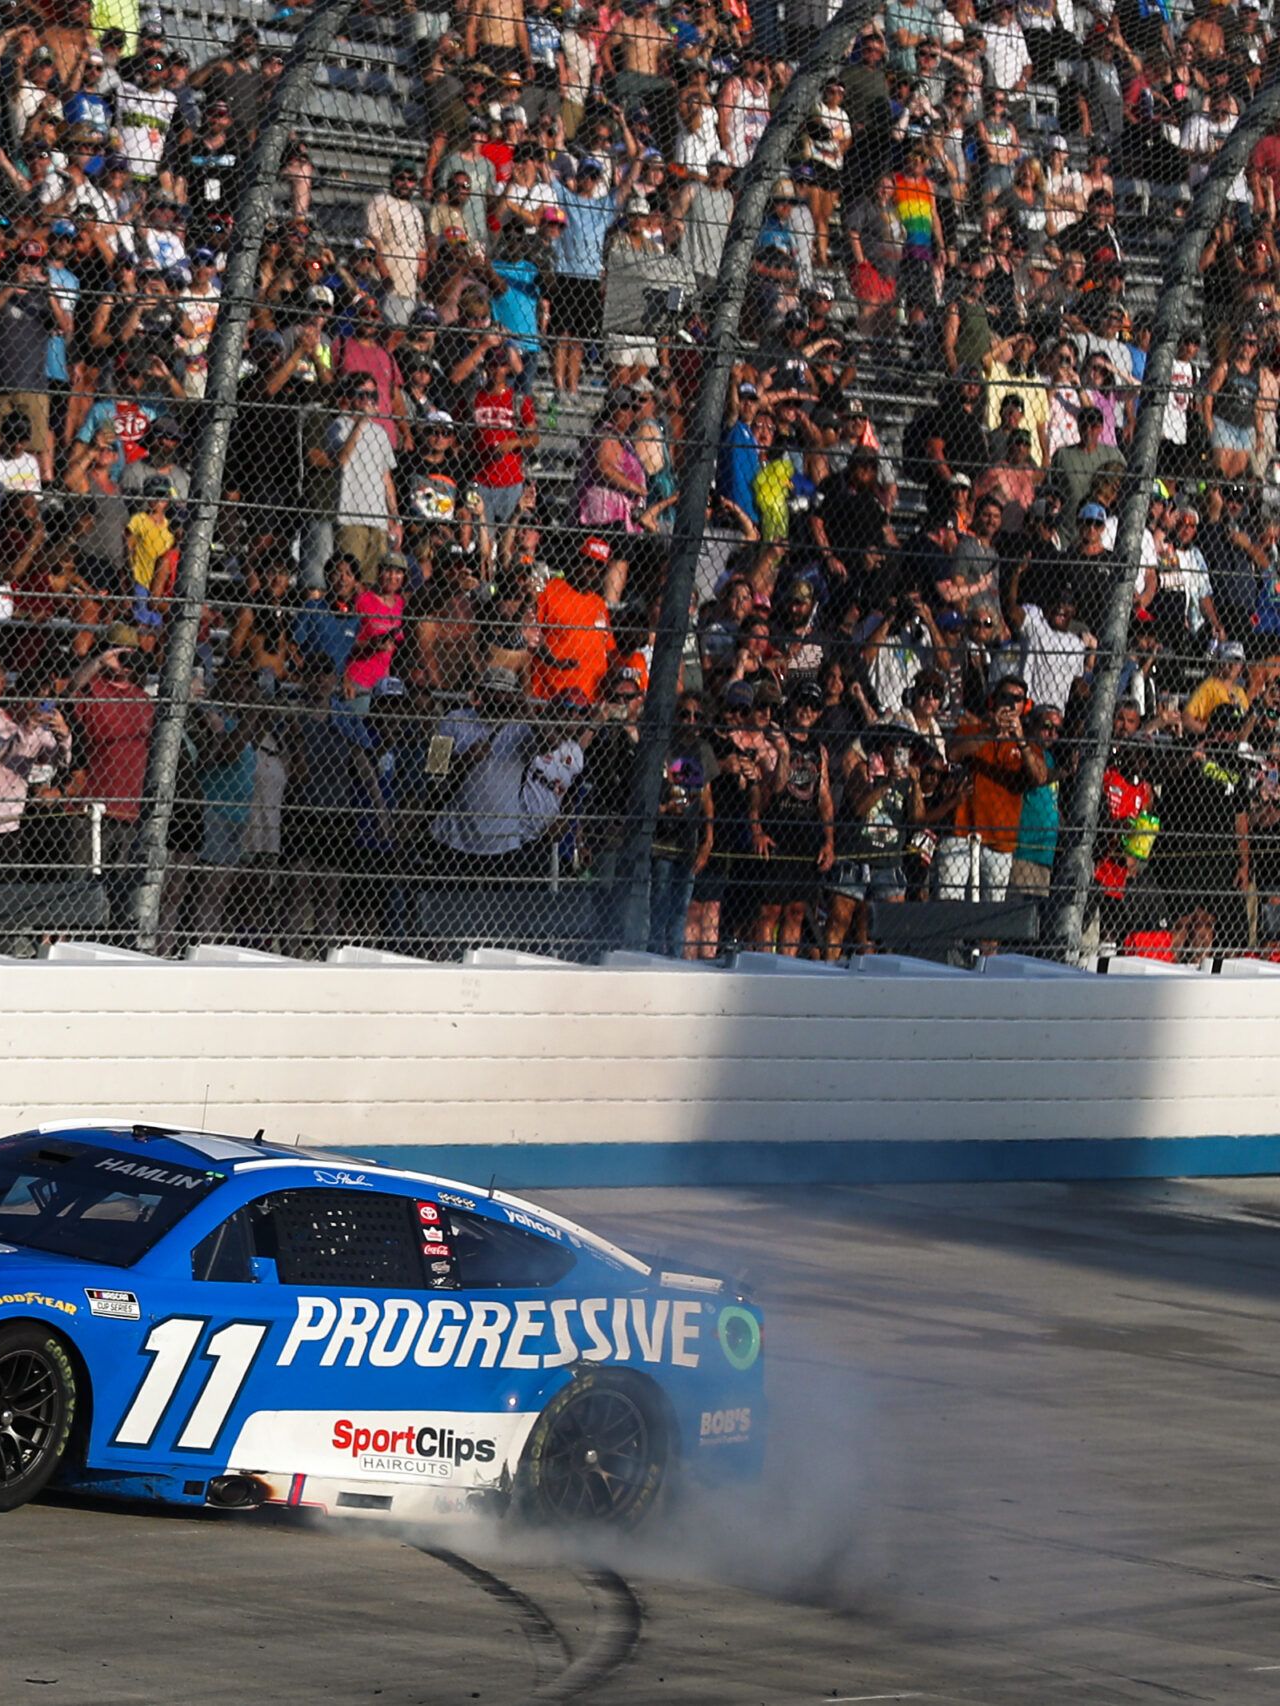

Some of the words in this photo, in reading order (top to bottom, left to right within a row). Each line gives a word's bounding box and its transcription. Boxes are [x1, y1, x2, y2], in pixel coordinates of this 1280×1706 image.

[94, 1157, 203, 1189] HAMLIN
[502, 1207, 562, 1241] yahoo!
[97, 1301, 109, 1310] CUP
[275, 1296, 702, 1369] PROGRESSIVE
[109, 1314, 273, 1453] 11
[700, 1407, 751, 1436] BOB'S
[363, 1456, 449, 1476] HAIRCUTS
